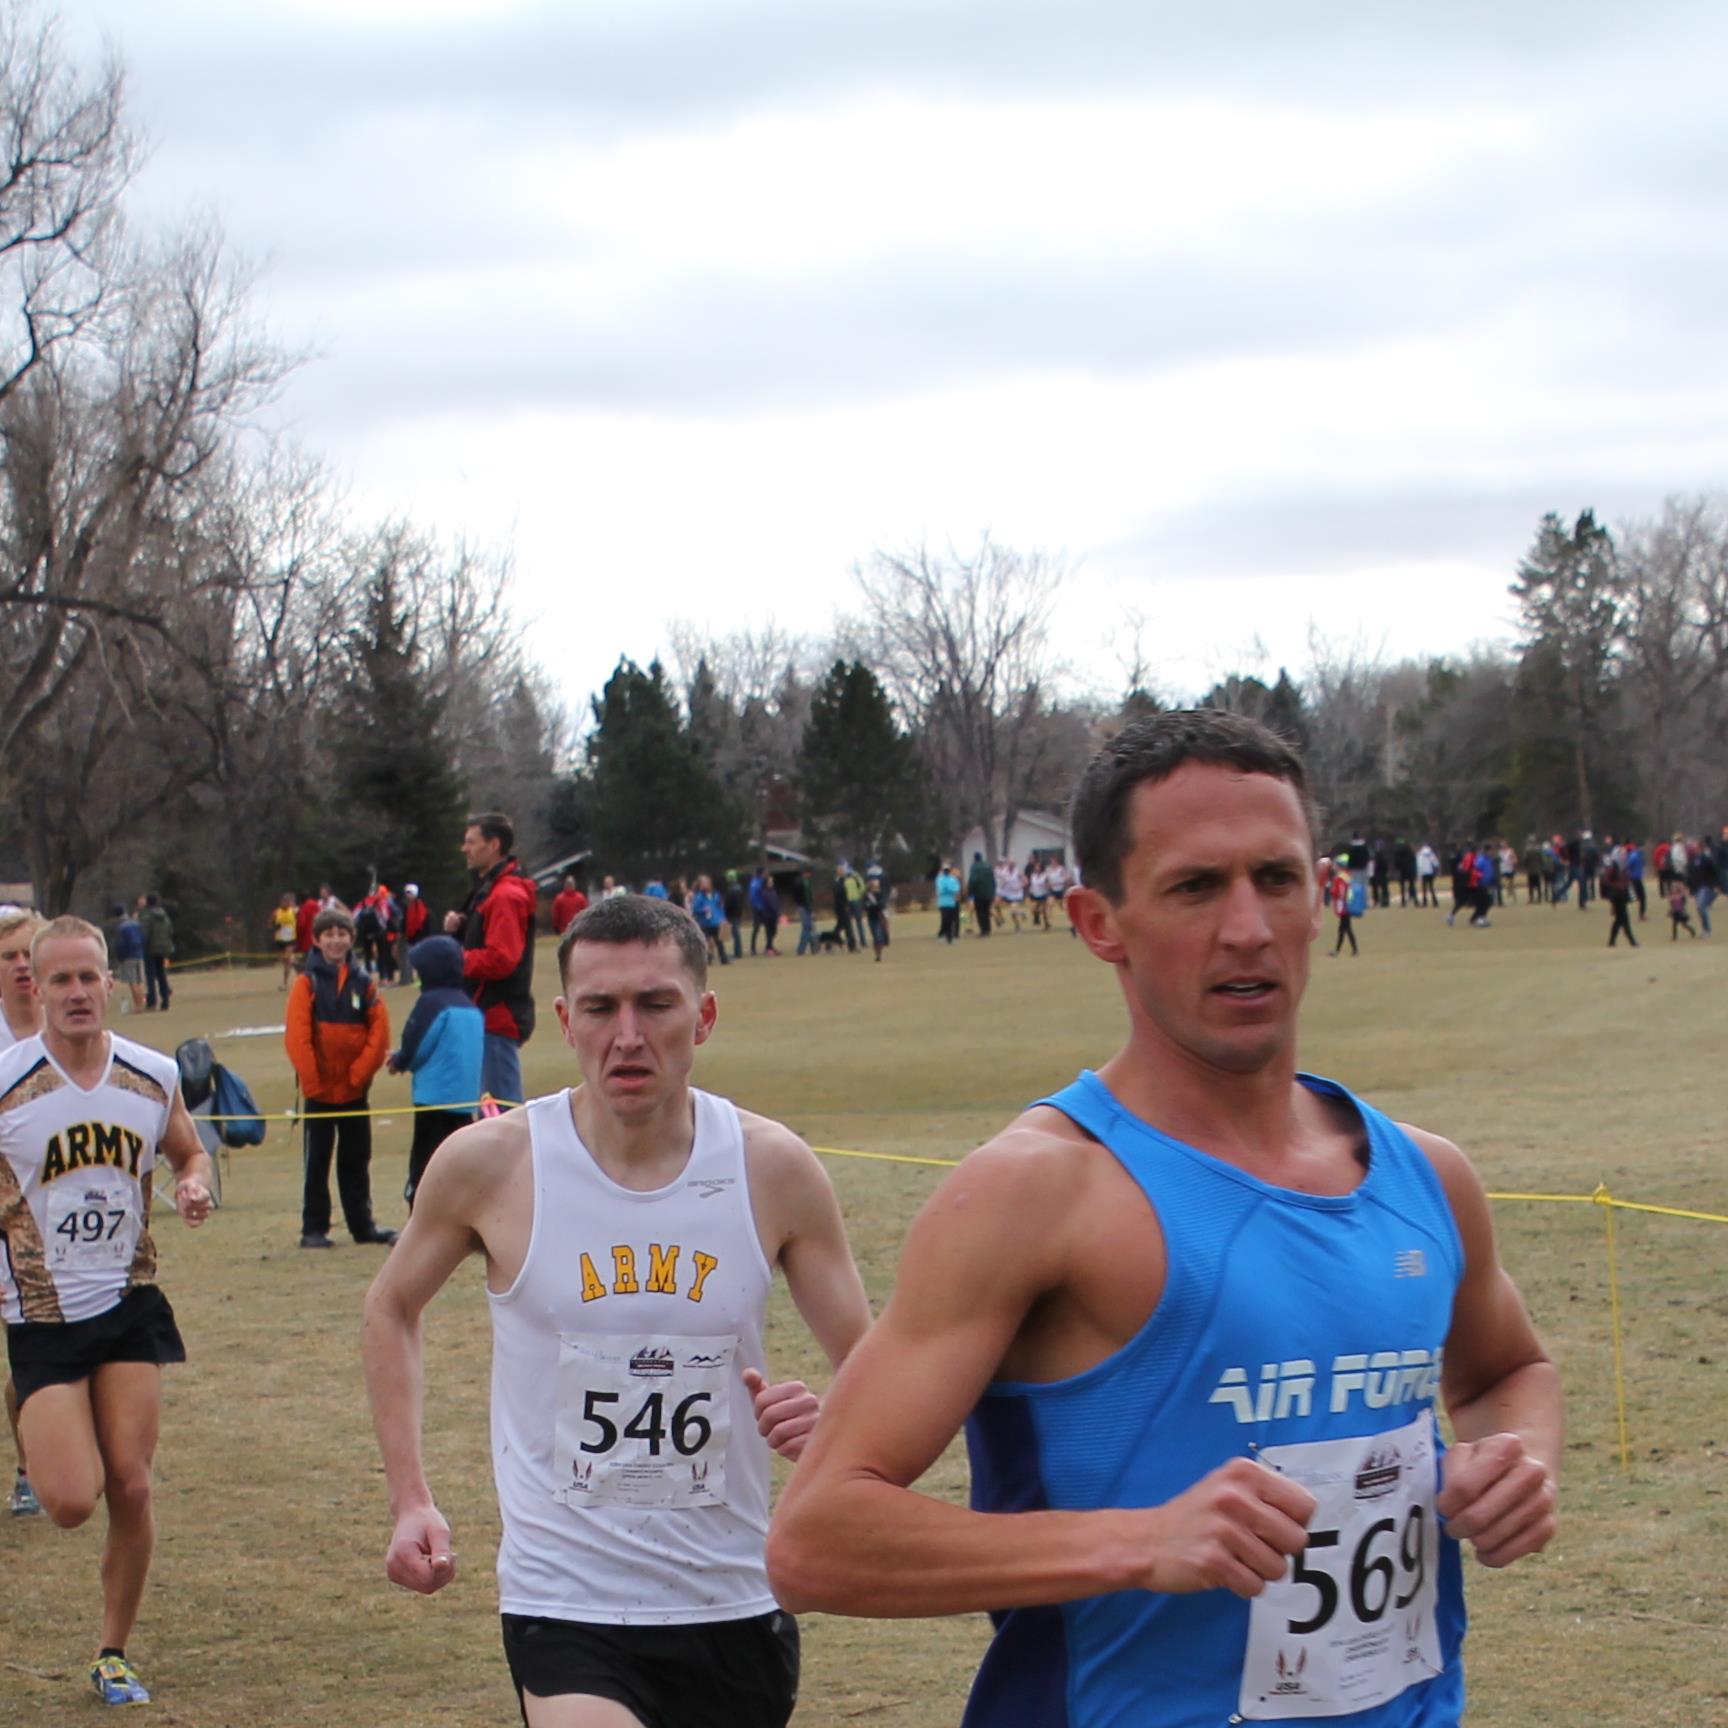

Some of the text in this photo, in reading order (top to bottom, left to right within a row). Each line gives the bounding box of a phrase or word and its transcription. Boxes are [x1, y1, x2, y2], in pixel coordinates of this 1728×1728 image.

[40, 1120, 144, 1188] ARMY
[56, 1209, 125, 1243] 497
[579, 1243, 718, 1303] ARMY
[580, 1390, 712, 1456] 546
[1208, 1359, 1316, 1423] AIR
[1287, 1504, 1425, 1635] 569
